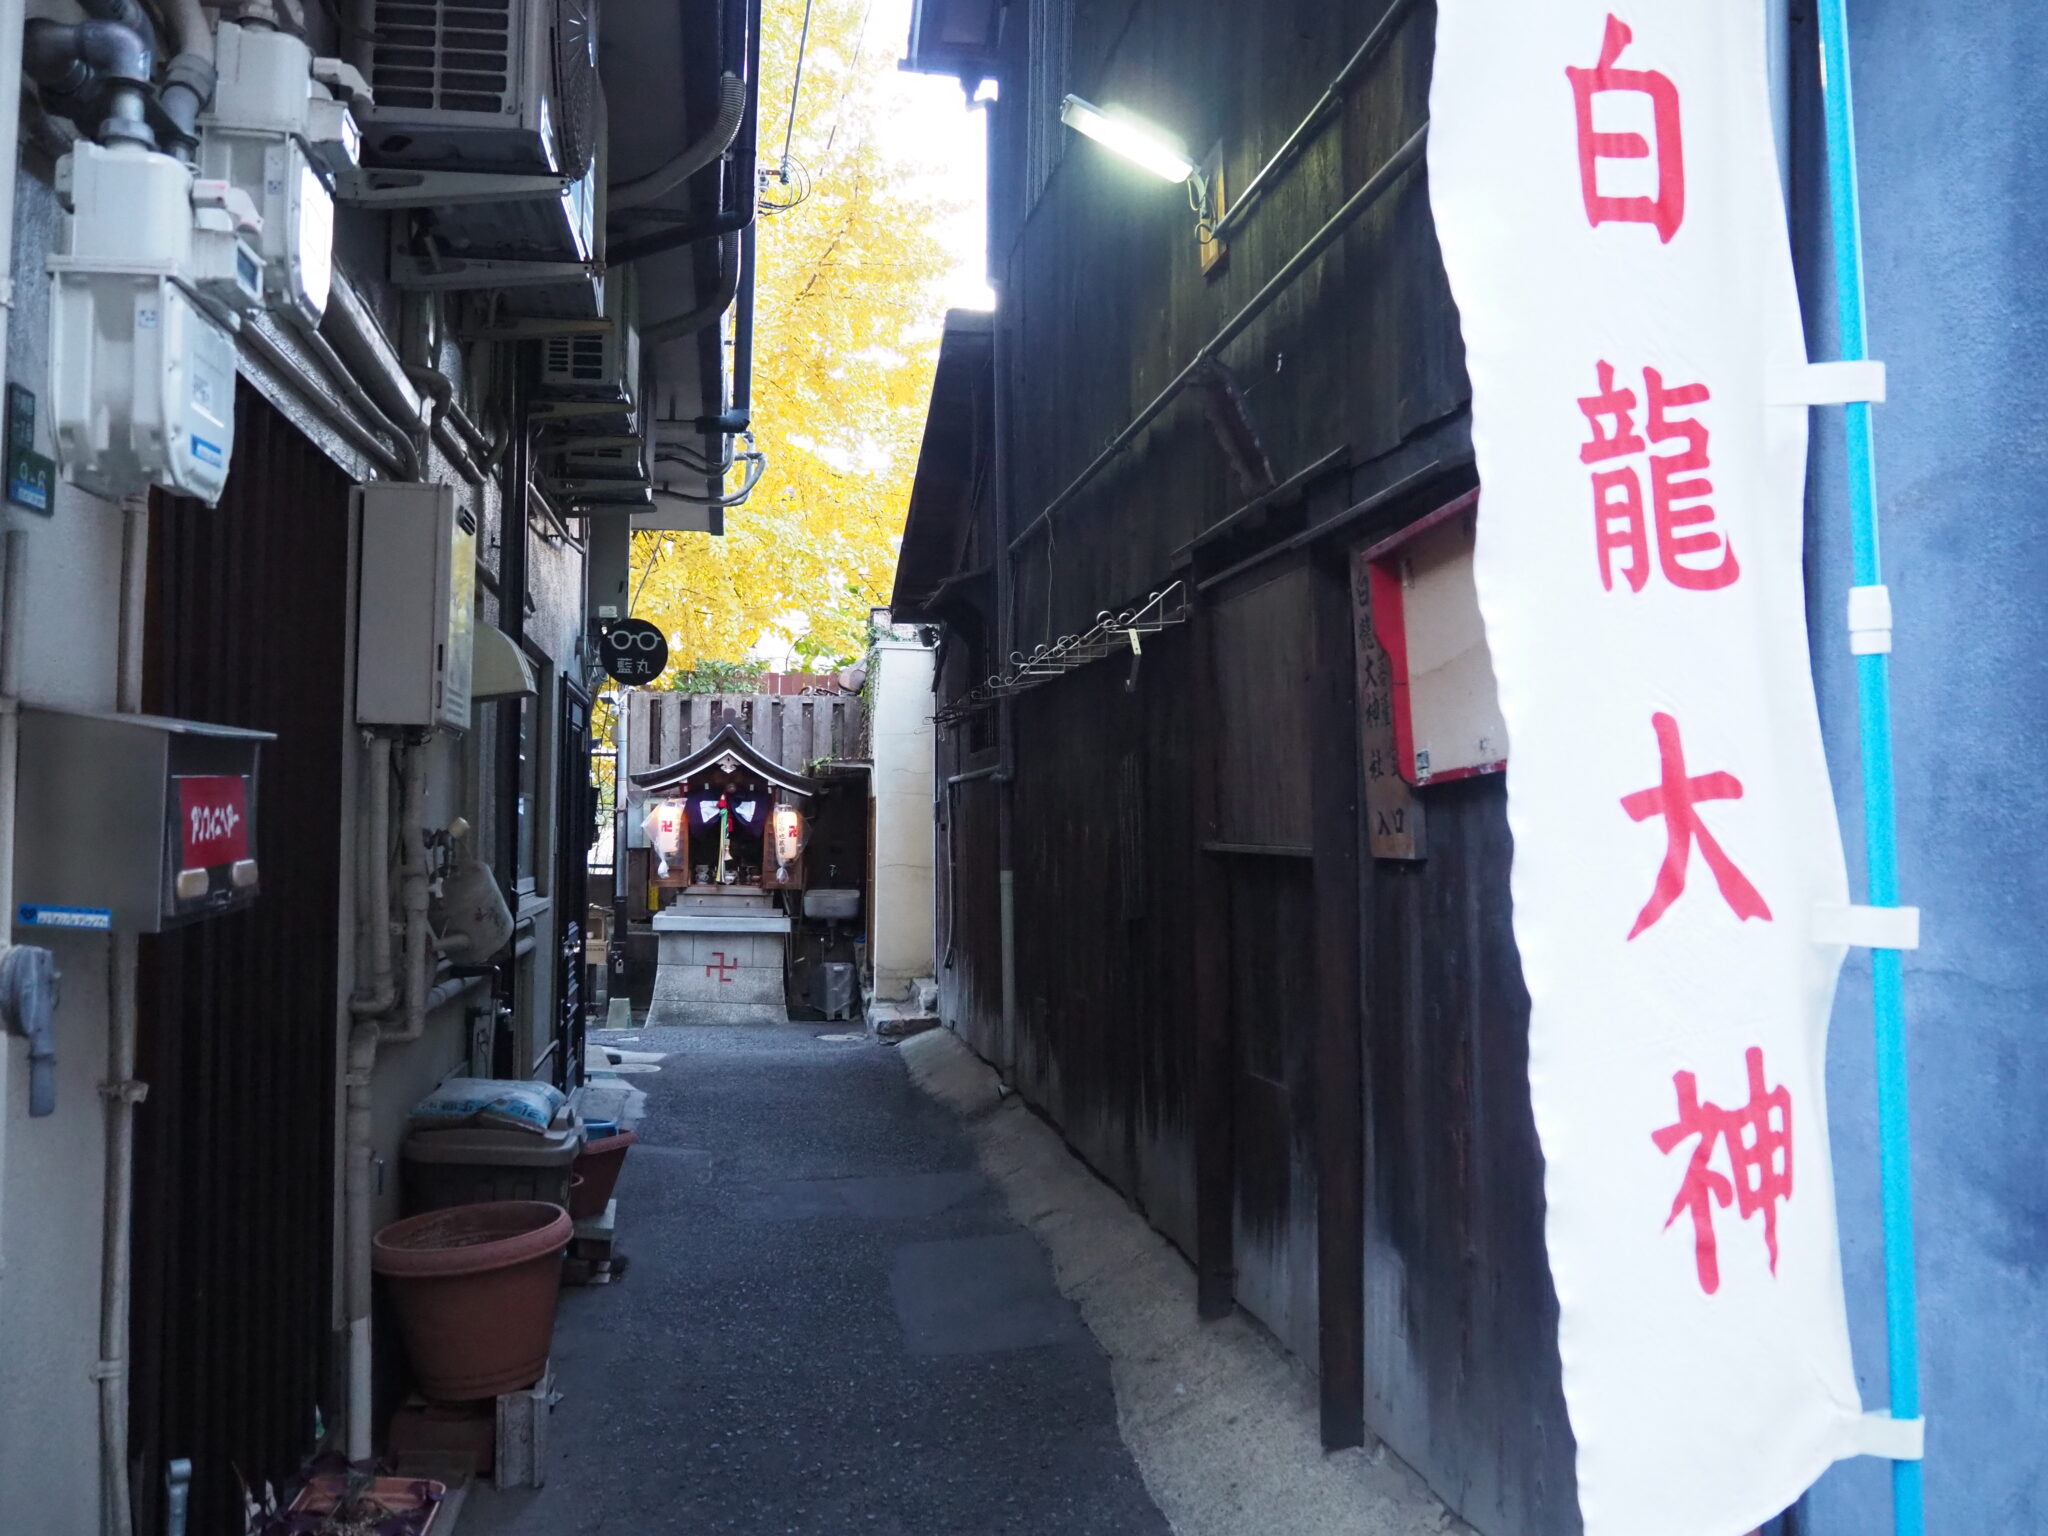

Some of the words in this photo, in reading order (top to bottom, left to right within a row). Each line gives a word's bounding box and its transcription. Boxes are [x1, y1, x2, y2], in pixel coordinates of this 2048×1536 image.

[616, 657, 652, 674] 藍丸
[1565, 12, 1794, 1295] 白龍大神
